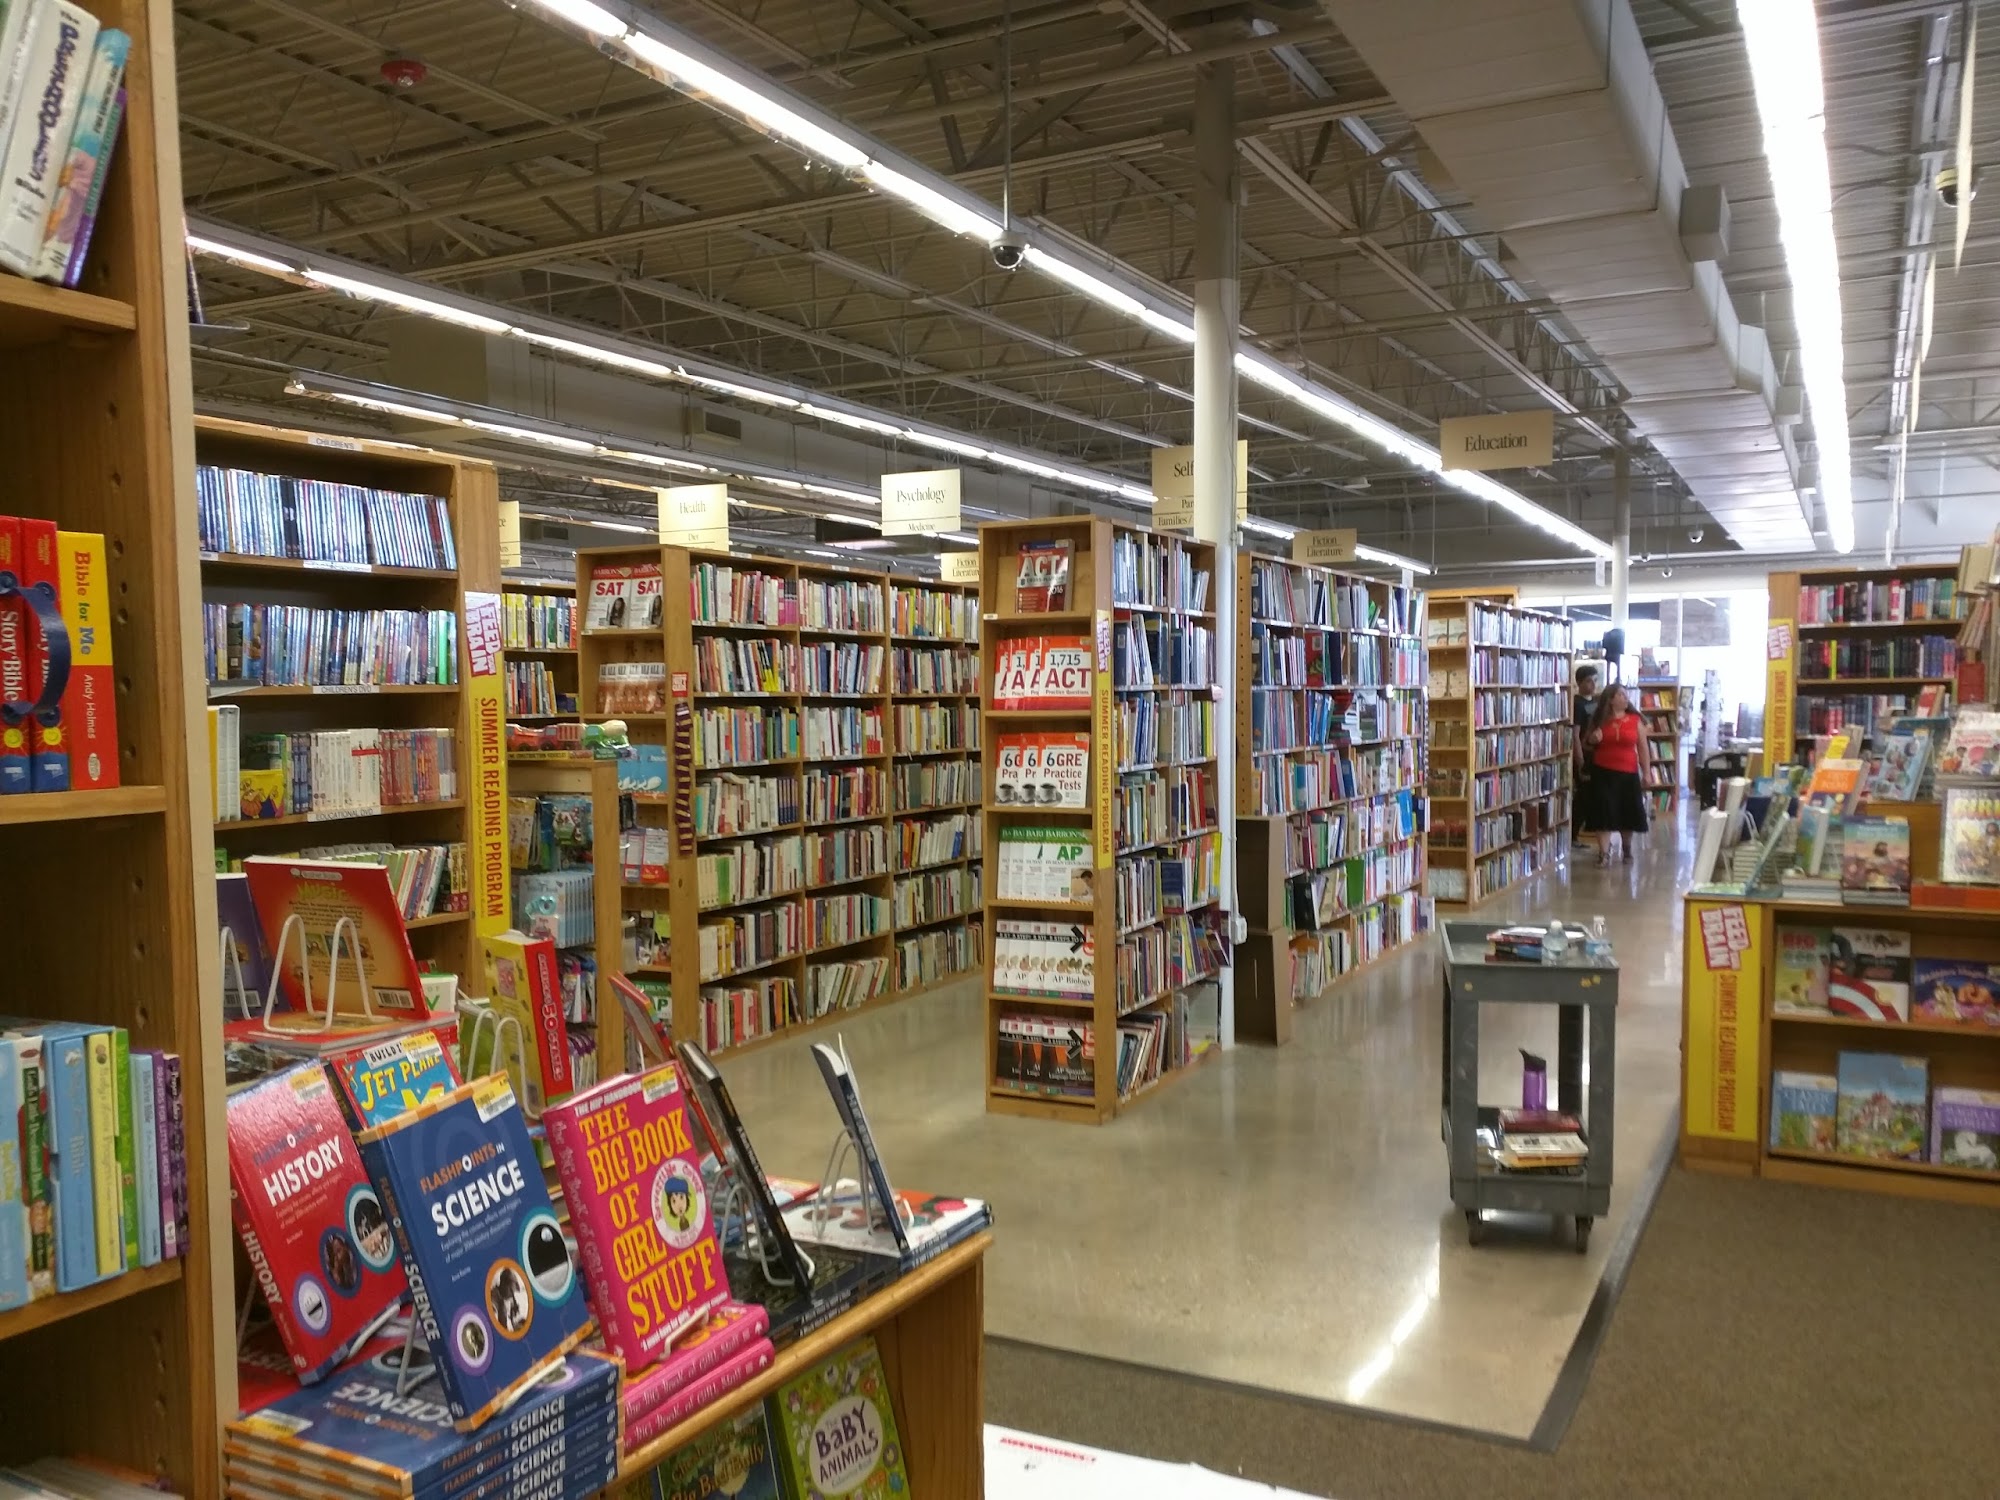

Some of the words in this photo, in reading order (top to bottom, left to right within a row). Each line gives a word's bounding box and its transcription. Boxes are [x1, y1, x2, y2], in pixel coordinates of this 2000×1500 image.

[315, 437, 355, 449] CHILDREN'S
[1464, 433, 1528, 452] Education
[679, 500, 706, 515] Health
[896, 487, 946, 506] Psychology
[907, 522, 936, 532] Medicine
[1158, 515, 1187, 526] Families
[1312, 534, 1337, 546] Fiction
[956, 558, 977, 567] Fiction
[1020, 555, 1060, 578] ACT
[1306, 546, 1343, 557] Literature
[74, 551, 91, 597] Bible
[595, 582, 624, 596] SAT
[637, 580, 661, 595] SAT
[78, 602, 90, 620] for
[479, 606, 501, 655] FEED
[0, 610, 19, 655] Story
[79, 627, 94, 655] Me
[465, 608, 488, 673] BRAIN
[2, 655, 22, 702] Bible
[1045, 667, 1091, 689] ACT
[1050, 654, 1081, 668] 1,715
[82, 673, 94, 700] Andy
[320, 685, 357, 694] CHILDREN'S
[358, 686, 372, 694] DVD
[86, 702, 96, 739] Holmes
[480, 697, 499, 765] SUMMER
[1004, 752, 1013, 767] 6
[1028, 752, 1036, 767] 6
[1043, 768, 1082, 778] Practice
[1046, 752, 1055, 767] 6
[1056, 753, 1083, 767] GRE
[482, 769, 501, 837] READING
[1059, 780, 1081, 790] Tests
[315, 809, 359, 820] EDUCATIONAL
[360, 808, 374, 817] DVD
[1101, 797, 1109, 854] PROGRAM
[1057, 845, 1083, 860] AP
[485, 841, 503, 918] PROGRAM
[1724, 908, 1749, 949] FEED
[1053, 975, 1063, 983] AP
[1066, 976, 1091, 986] Biology
[1719, 974, 1738, 1022] SUMMER
[1718, 1026, 1737, 1074] READING
[157, 1066, 166, 1102] PRAYERS
[360, 1066, 398, 1112] JET
[578, 1102, 631, 1147] THE
[1718, 1078, 1736, 1132] PROGRAM
[160, 1124, 169, 1152] LITTLE
[587, 1134, 631, 1196] BIG
[626, 1107, 692, 1176] BOOK
[162, 1154, 171, 1186] HEARTS
[262, 1134, 344, 1208] HISTORY
[420, 1142, 497, 1195] FLASHPOINTS
[495, 1141, 505, 1154] IN
[431, 1158, 526, 1237] SCIENCE
[608, 1182, 640, 1229] OF
[242, 1230, 283, 1305] HISTORY
[613, 1218, 667, 1284] GIRL
[404, 1263, 442, 1342] SCIENCE
[626, 1236, 717, 1340] STUFF
[332, 1382, 454, 1428] SCIENCE
[443, 1432, 501, 1470] FLASHPOINTS
[510, 1394, 566, 1438] SCIENCE
[444, 1453, 503, 1493] FLASHPOINTS
[511, 1415, 565, 1458] SCIENCE
[512, 1434, 566, 1480] SCIENCE
[819, 1428, 879, 1483] ANIMALS
[512, 1454, 566, 1499] SCIENCE
